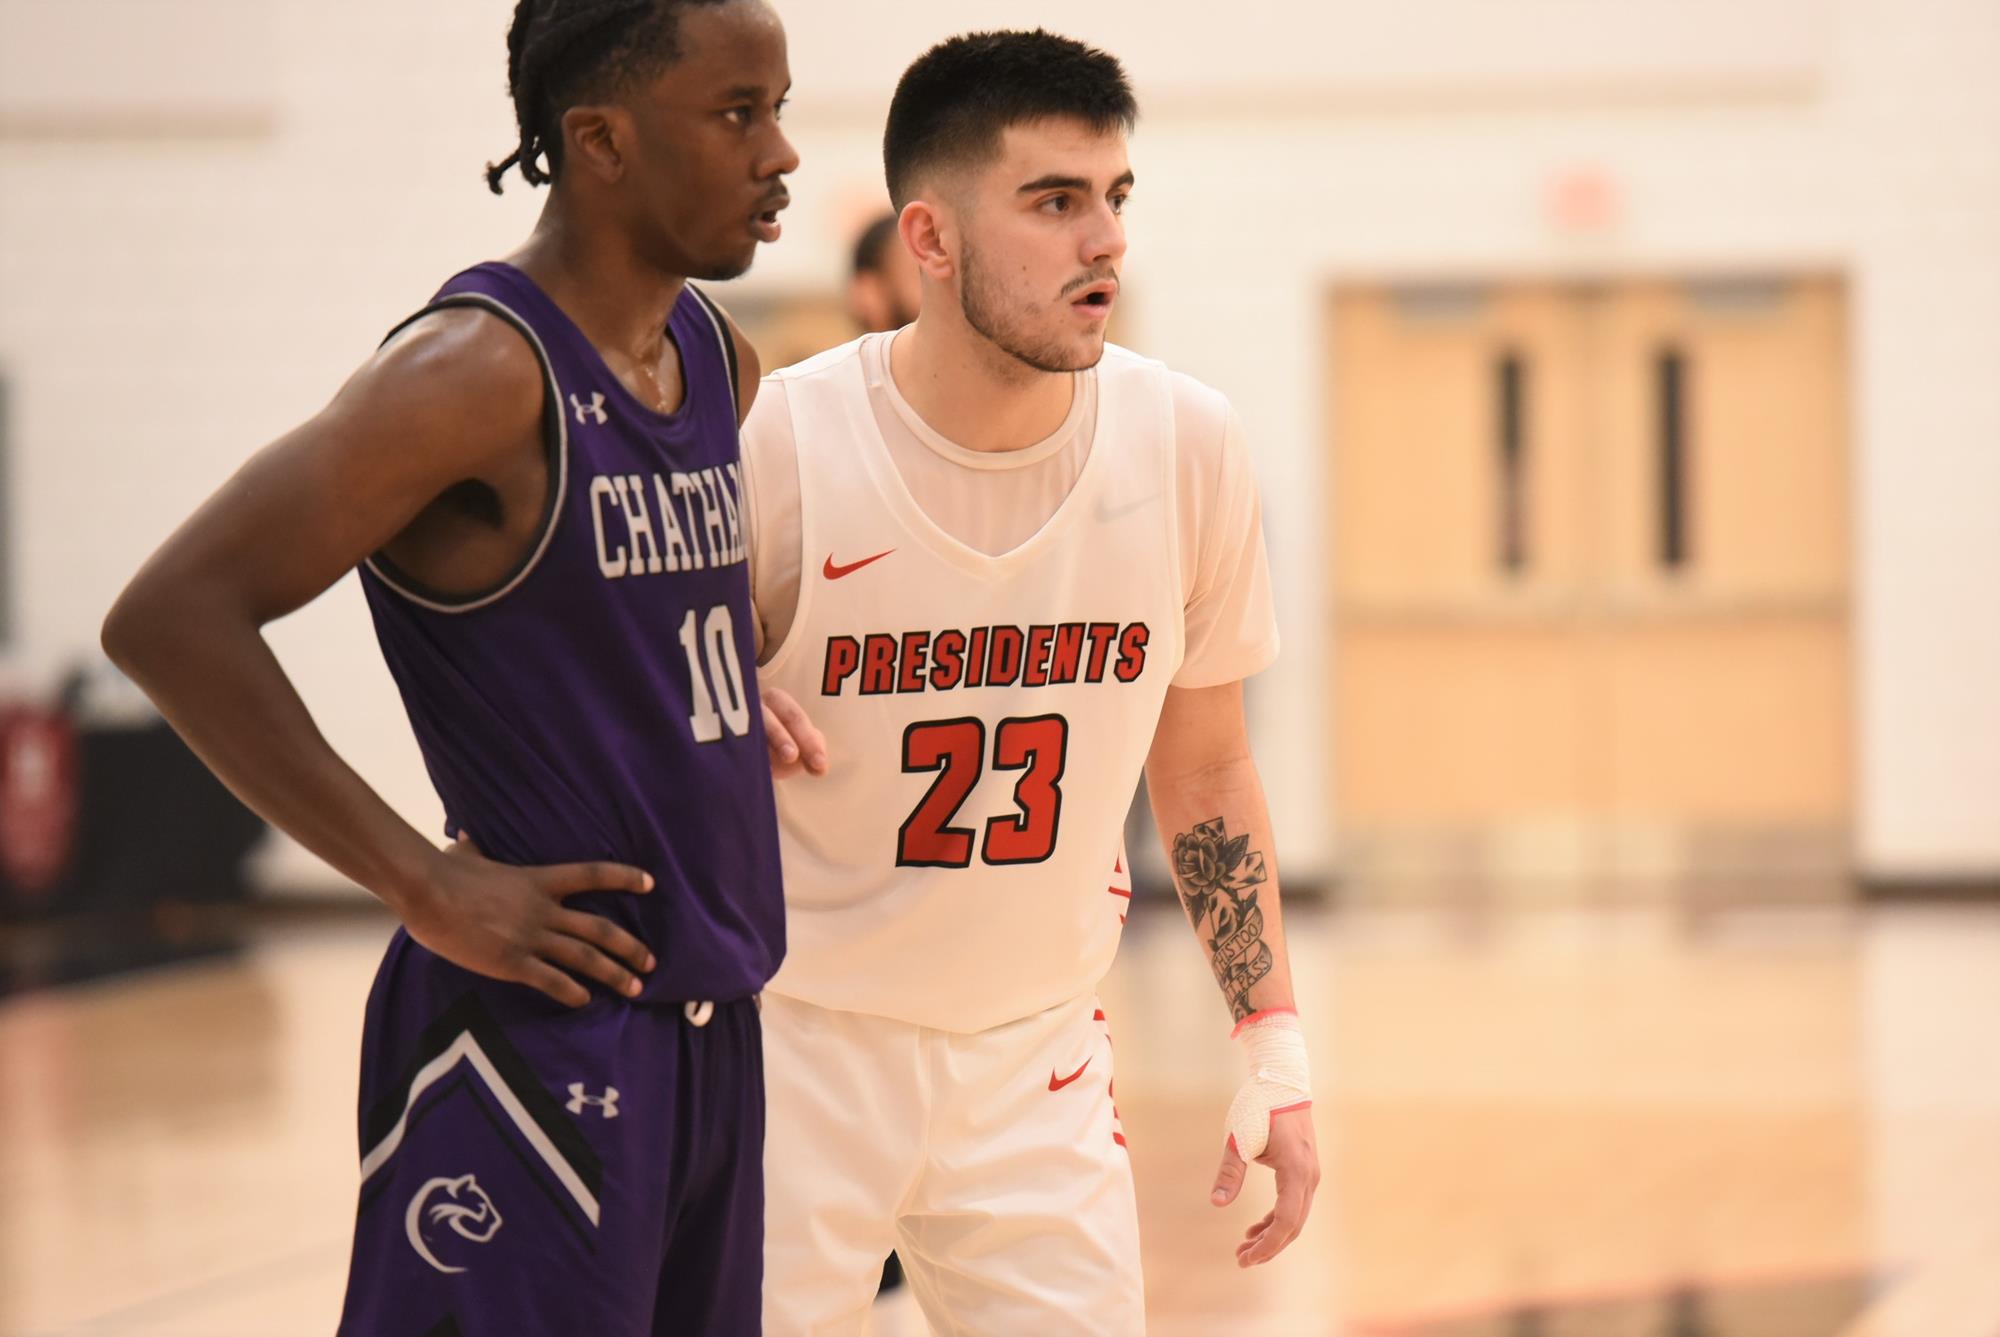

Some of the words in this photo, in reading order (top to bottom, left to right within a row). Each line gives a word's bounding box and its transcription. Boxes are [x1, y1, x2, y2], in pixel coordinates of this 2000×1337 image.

[679, 605, 749, 742] 10
[822, 622, 1150, 695] PRESIDENTS
[895, 713, 1068, 868] 23
[1230, 923, 1258, 951] TOO
[1236, 955, 1270, 992] PASS
